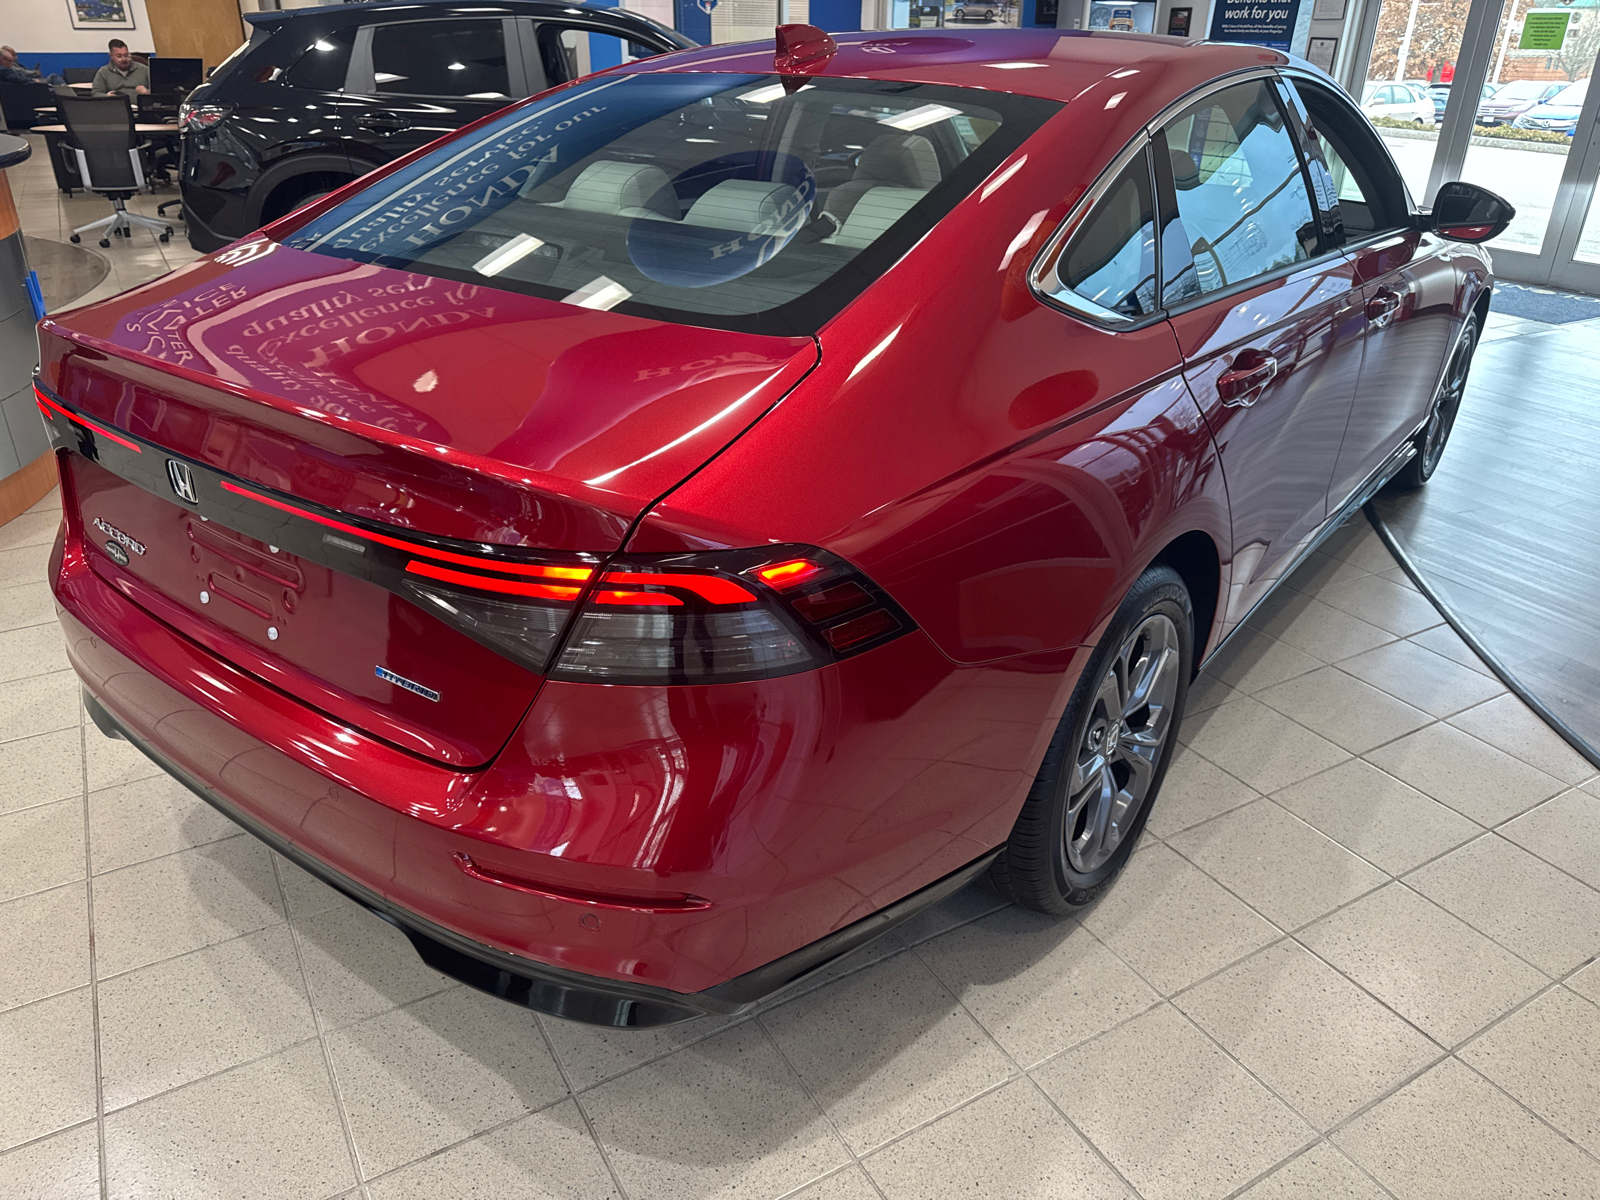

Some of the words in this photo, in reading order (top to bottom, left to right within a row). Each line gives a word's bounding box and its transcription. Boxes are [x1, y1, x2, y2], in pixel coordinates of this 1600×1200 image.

[1225, 6, 1250, 19] work
[1251, 5, 1267, 19] for
[1266, 10, 1289, 22] you
[93, 517, 146, 555] ACCORD
